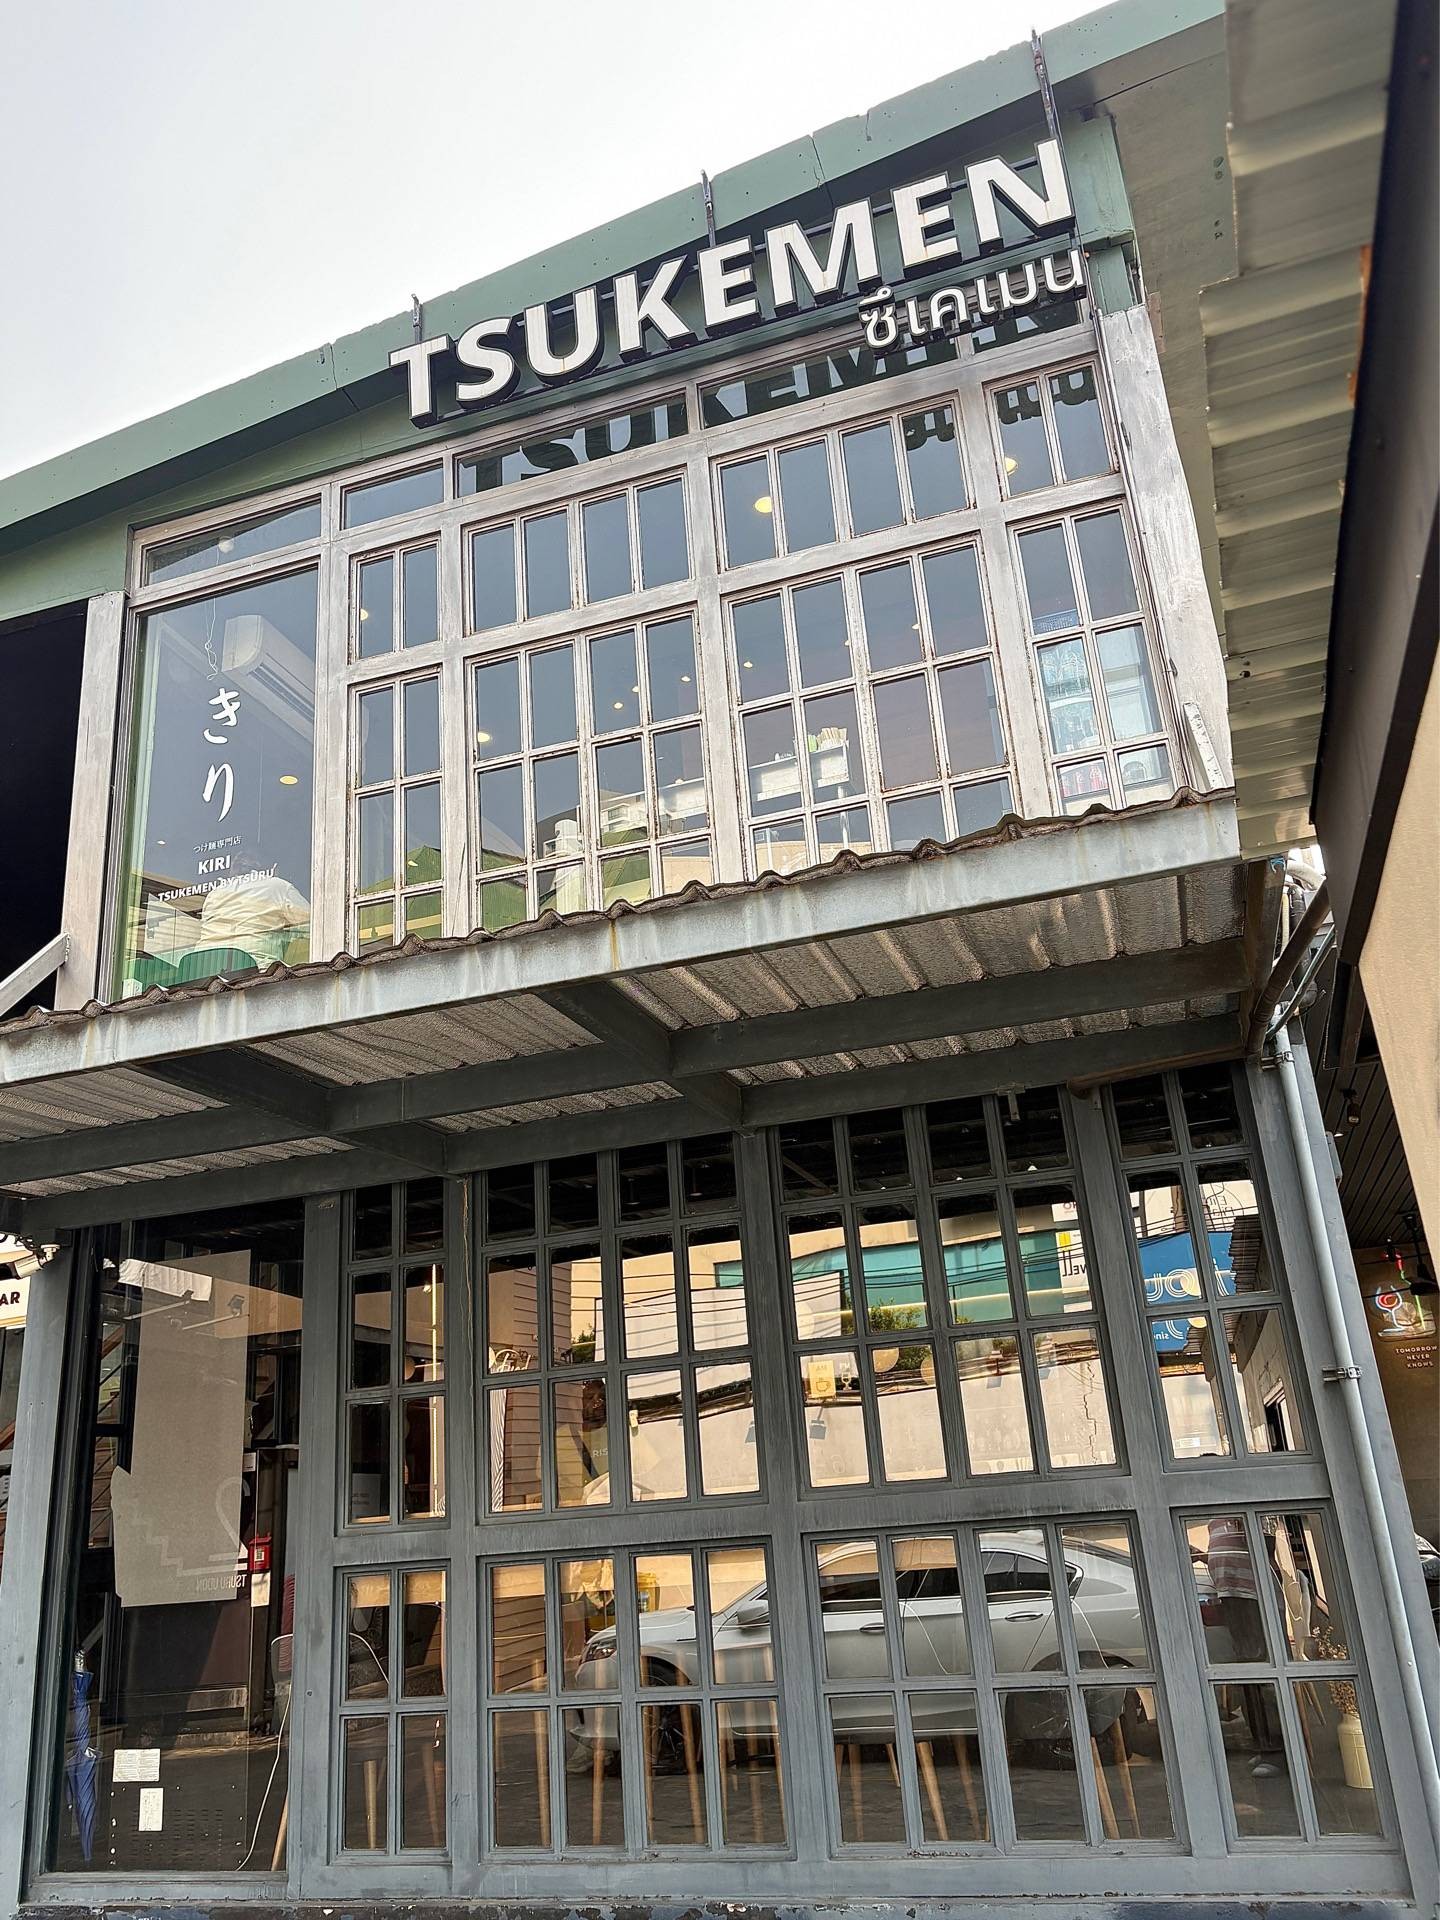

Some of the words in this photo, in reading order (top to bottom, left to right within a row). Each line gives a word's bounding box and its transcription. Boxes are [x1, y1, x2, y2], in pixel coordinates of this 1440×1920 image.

[389, 138, 1074, 428] TSUKEMEN
[202, 687, 241, 823] きり
[198, 855, 231, 875] KIRI
[158, 881, 217, 902] TSUKEMEN
[1395, 1346, 1438, 1354] TOMORROW
